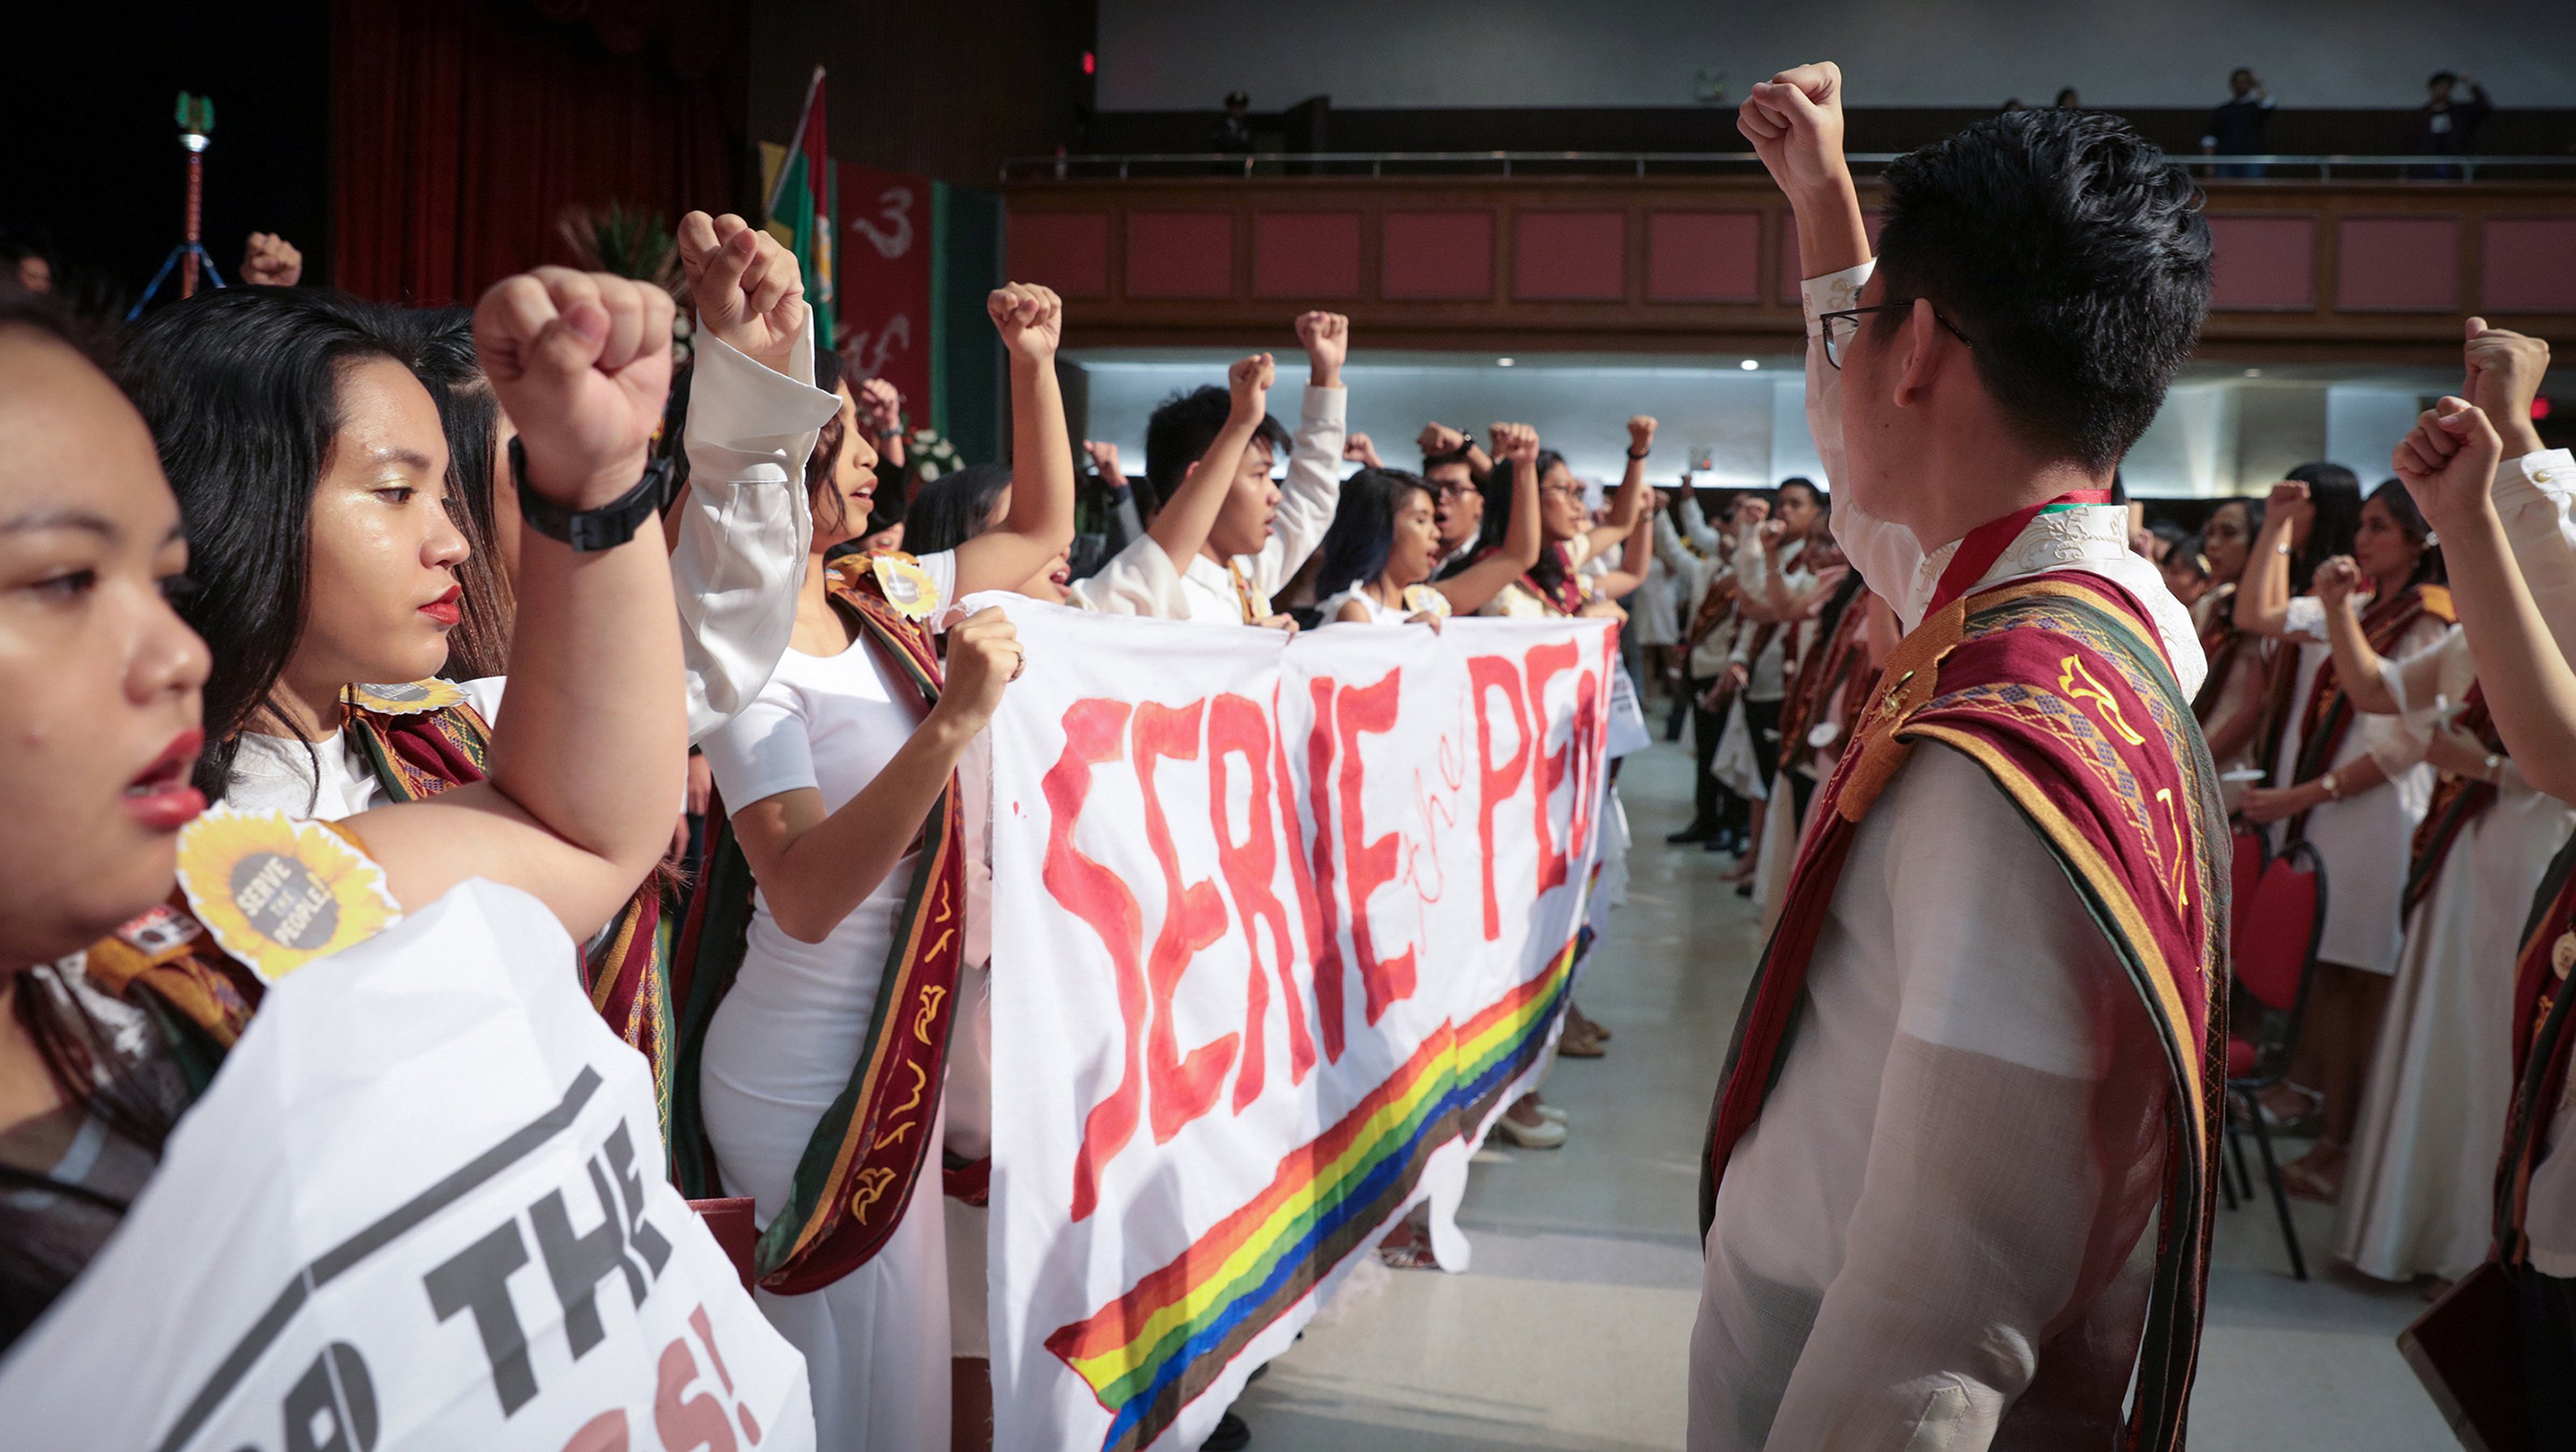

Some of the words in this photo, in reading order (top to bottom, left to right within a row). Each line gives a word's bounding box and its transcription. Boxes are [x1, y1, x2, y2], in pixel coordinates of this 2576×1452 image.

[236, 855, 292, 917] SERVE
[268, 889, 296, 919] THE
[274, 871, 333, 948] PEOPLE!
[1042, 666, 1419, 1223] SERVE
[1402, 682, 1466, 956] the
[422, 1114, 673, 1420] THE
